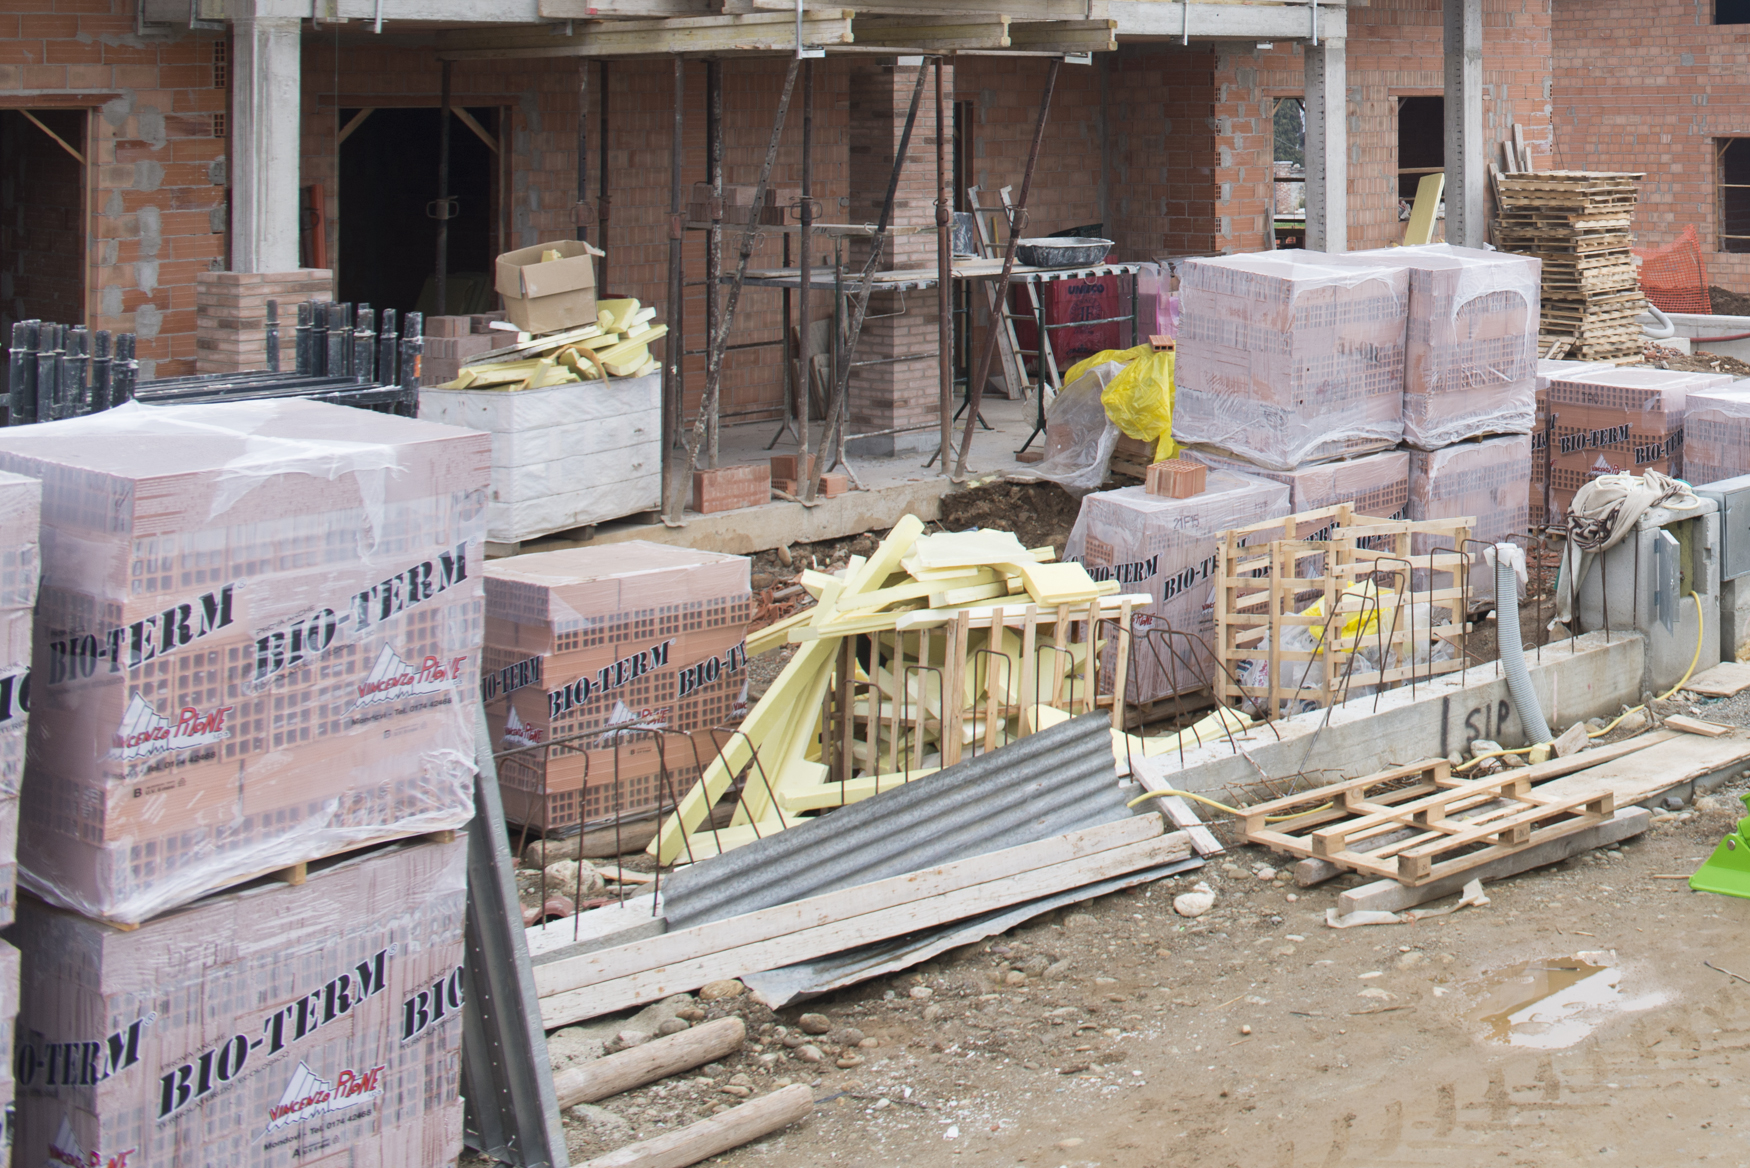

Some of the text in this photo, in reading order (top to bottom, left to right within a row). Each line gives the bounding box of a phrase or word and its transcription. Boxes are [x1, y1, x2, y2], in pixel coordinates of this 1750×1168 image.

[1560, 423, 1630, 454] BIO-TERM
[49, 582, 235, 686] BIO-TERM
[254, 540, 468, 682] BIO-TERM
[357, 655, 468, 699] VINCENZO PILONE
[547, 641, 671, 720] BIO-TERM
[173, 706, 233, 739] PILONE
[1465, 699, 1510, 746] SIP
[157, 948, 388, 1120] BIO-TERM
[268, 1065, 386, 1122] VINCENZO PILONE
[326, 1117, 346, 1130] 0174
